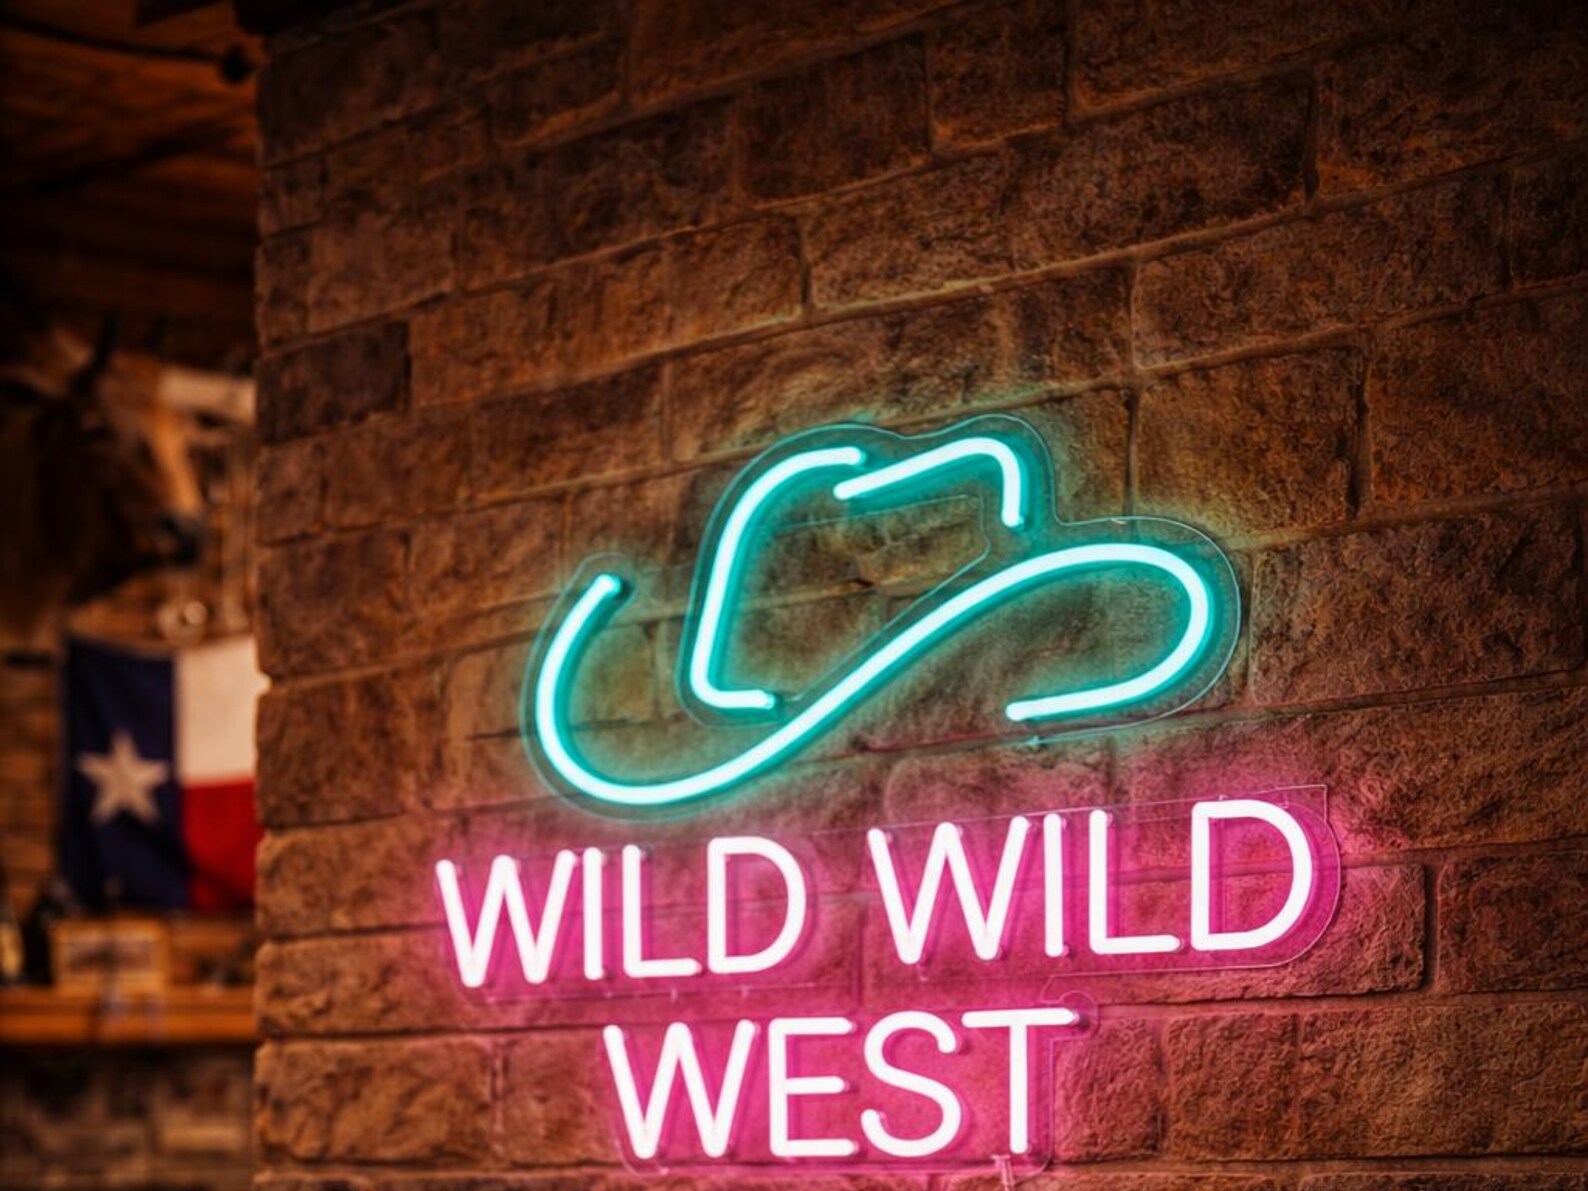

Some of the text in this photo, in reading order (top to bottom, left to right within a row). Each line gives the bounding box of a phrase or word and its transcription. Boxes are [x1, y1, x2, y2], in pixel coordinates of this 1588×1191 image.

[436, 799, 1313, 988] WILD WILD
[603, 1007, 1080, 1160] WEST
